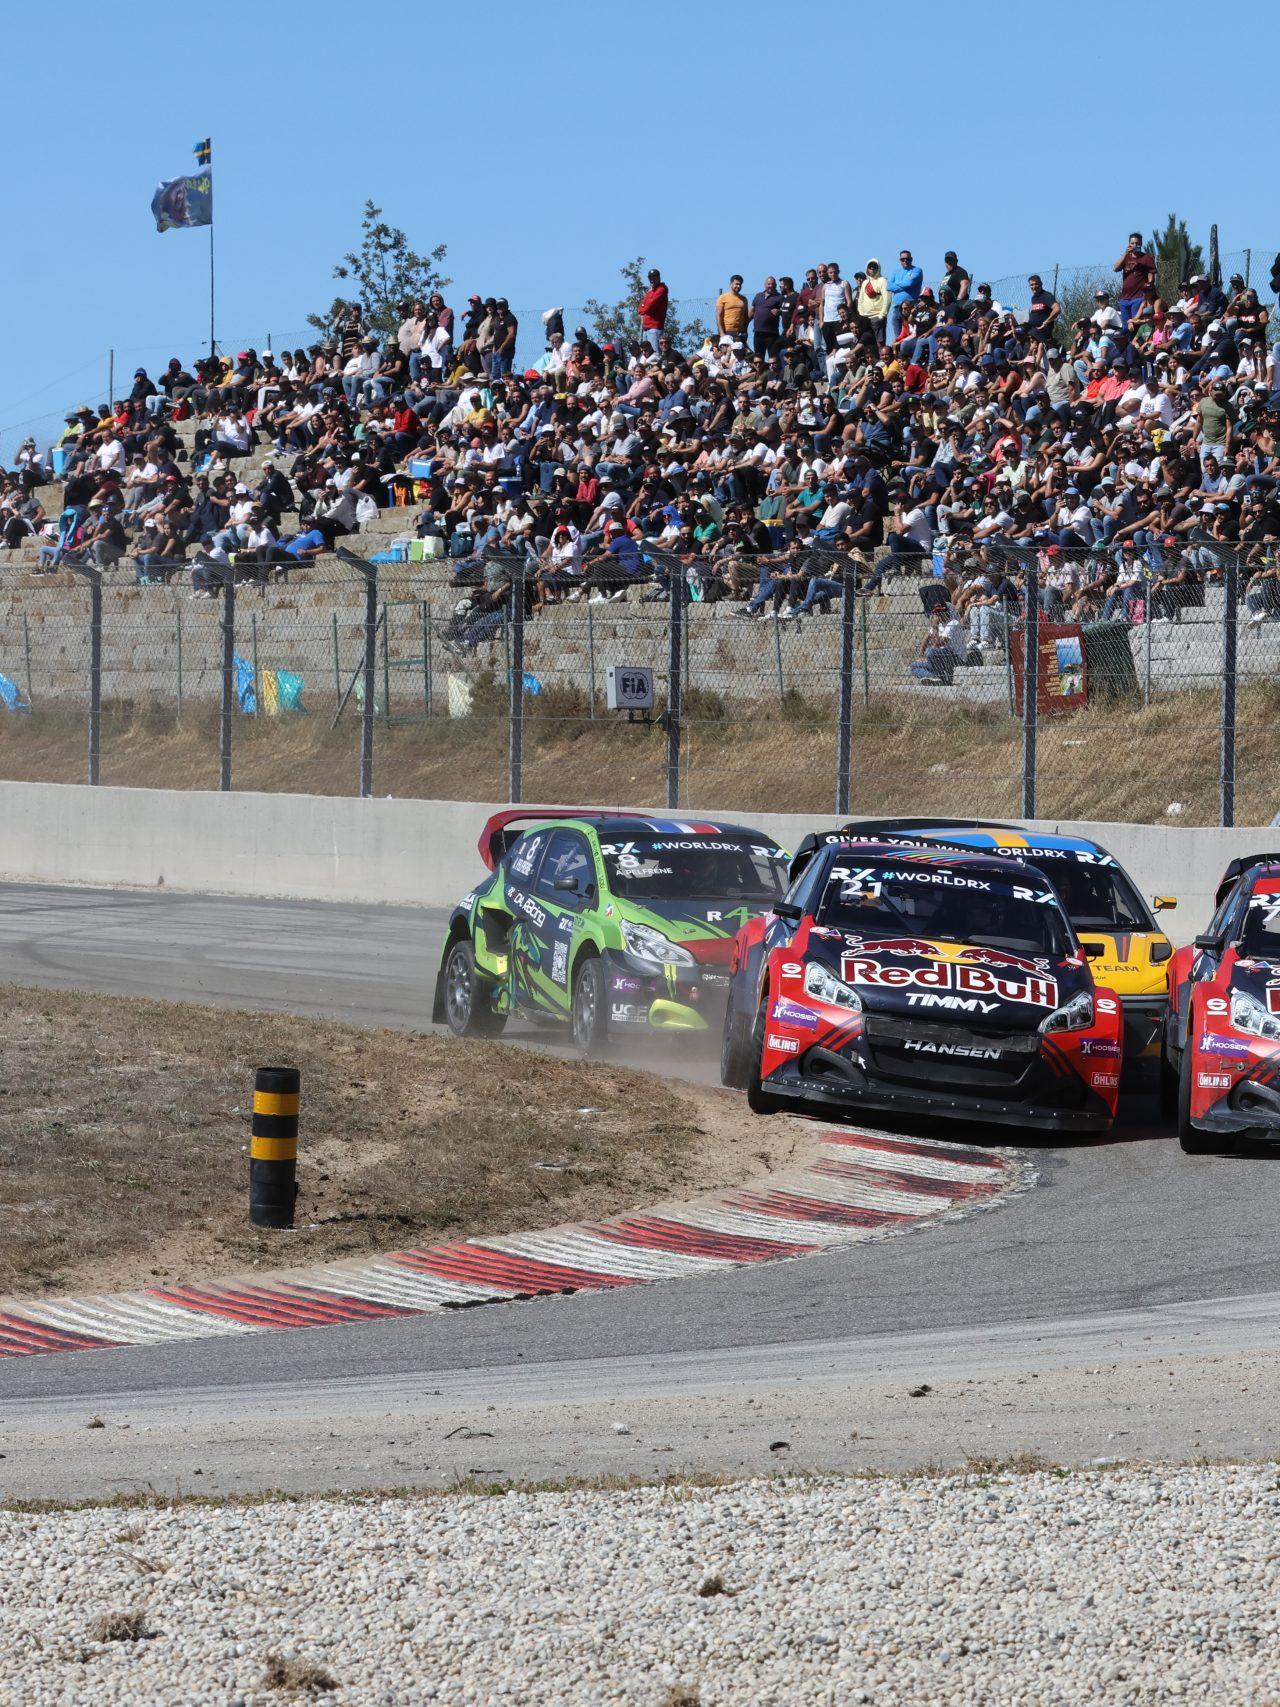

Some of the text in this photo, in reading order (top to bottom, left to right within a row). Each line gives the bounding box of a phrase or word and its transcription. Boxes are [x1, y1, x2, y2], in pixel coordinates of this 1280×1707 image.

[652, 841, 744, 853] #WORLDRX
[992, 847, 1068, 859] ORLDRX
[618, 854, 640, 868] 8
[840, 879, 882, 897] 21
[882, 871, 991, 891] #WORLDRX
[841, 957, 1059, 1010] Red Bull
[905, 993, 1002, 1014] TIMMY
[783, 1009, 818, 1022] HOOSIER
[904, 1039, 1003, 1060] HANSEN
[1211, 1042, 1249, 1051] HOOSIER
